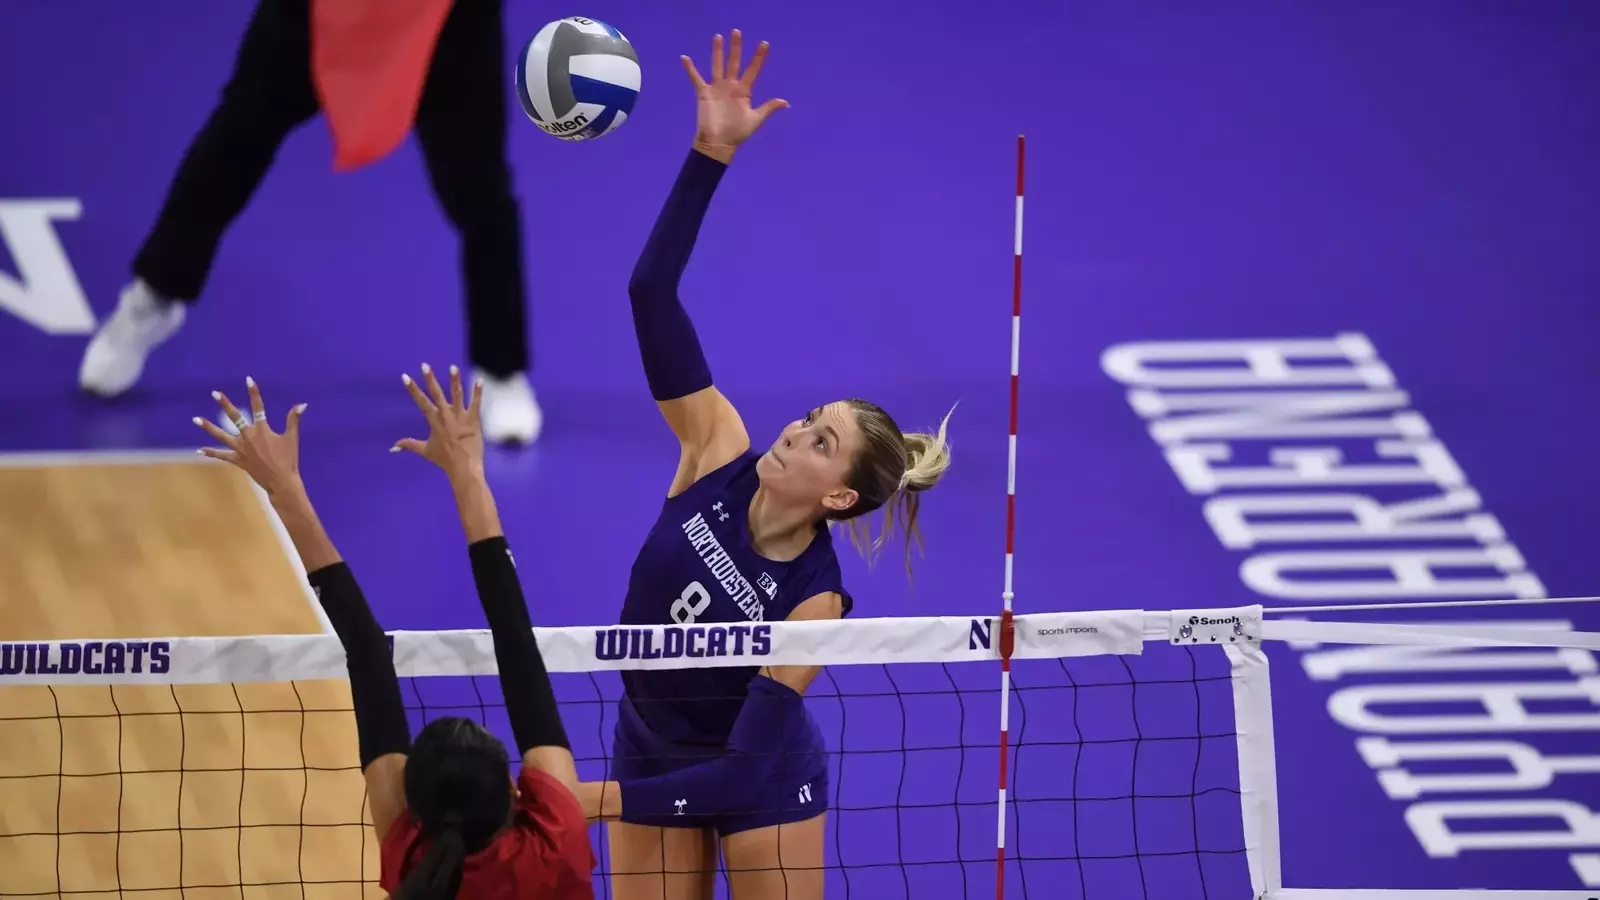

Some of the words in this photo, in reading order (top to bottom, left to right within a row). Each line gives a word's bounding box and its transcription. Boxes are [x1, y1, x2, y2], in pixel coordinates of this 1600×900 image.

[539, 115, 589, 133] olten
[1100, 333, 1548, 599] ARENA
[669, 580, 711, 624] 8
[969, 619, 991, 649] N
[1037, 627, 1064, 636] sports
[1200, 616, 1240, 625] Senoh
[595, 625, 771, 660] WILDCATS
[0, 642, 170, 675] WILDCATS
